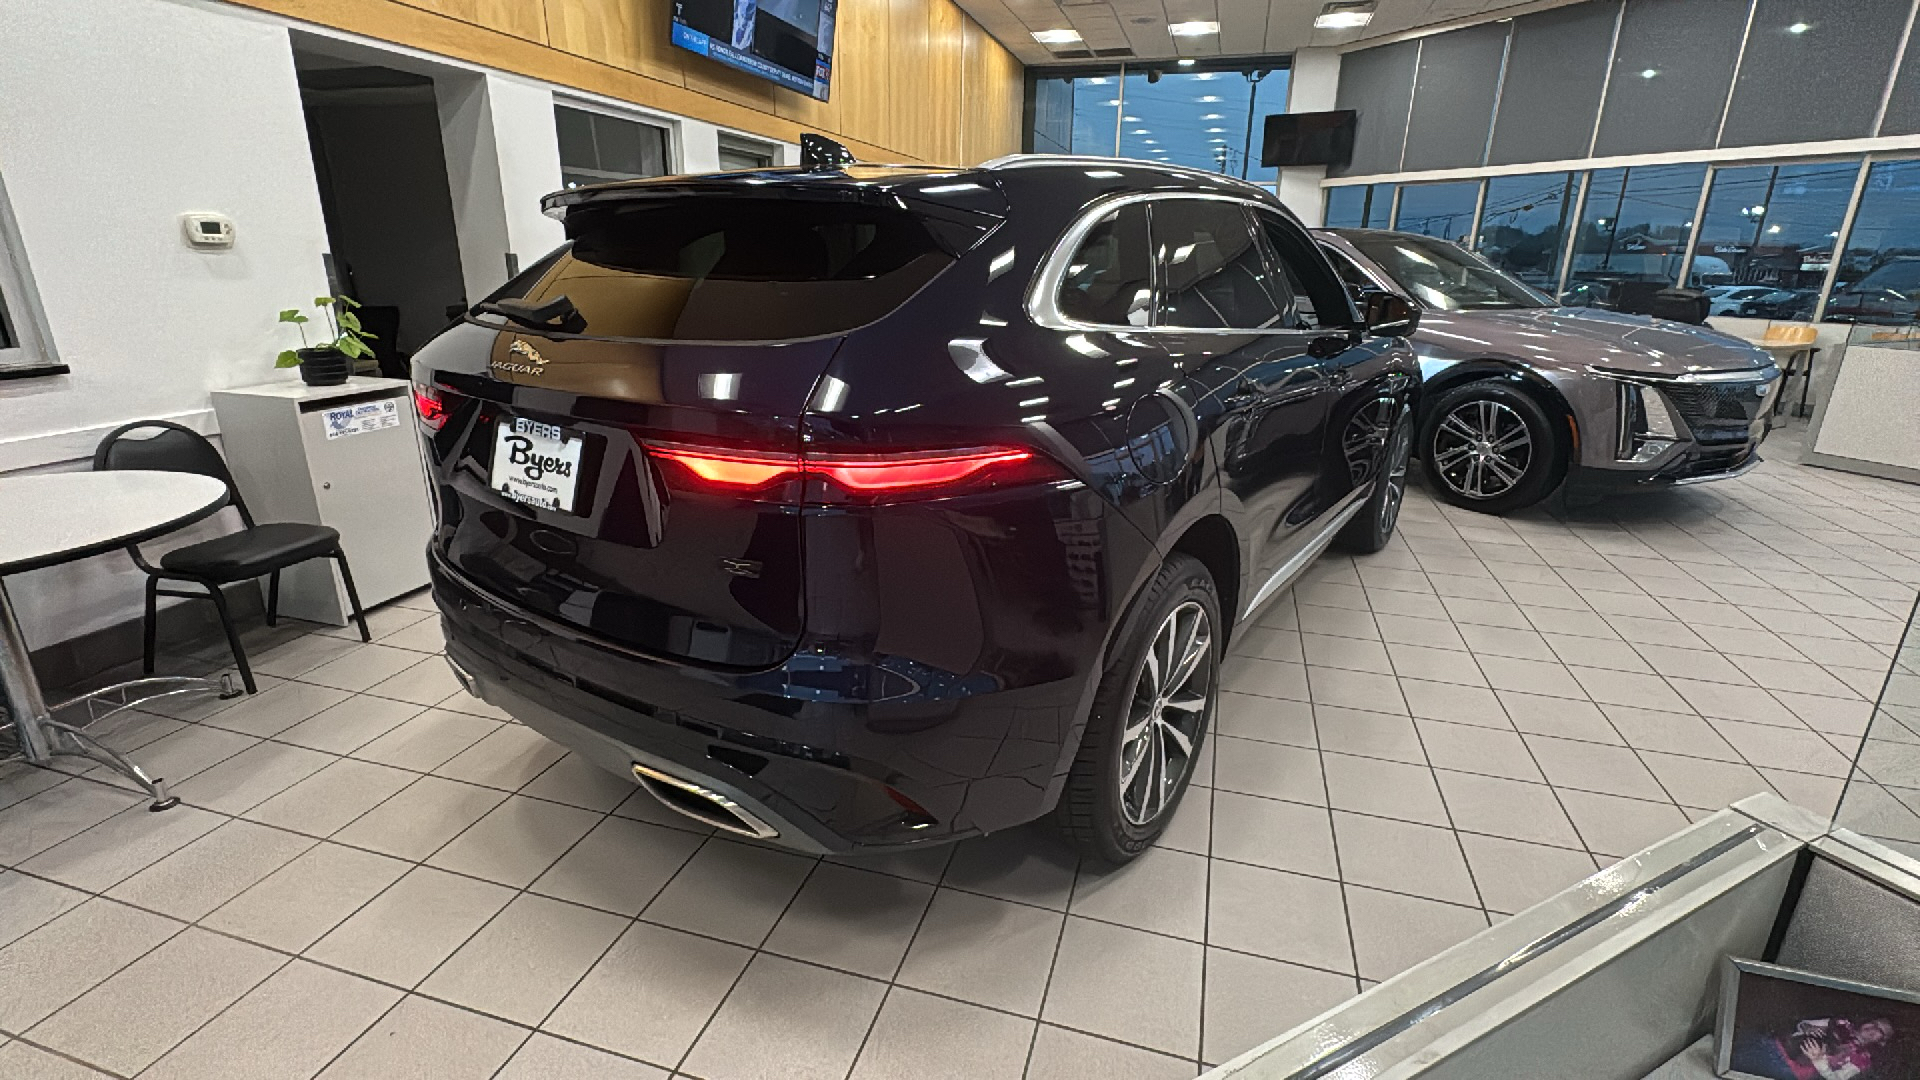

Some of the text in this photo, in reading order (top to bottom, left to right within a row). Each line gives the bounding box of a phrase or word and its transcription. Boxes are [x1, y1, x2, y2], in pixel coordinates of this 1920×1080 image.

[490, 360, 545, 377] JAGUAR
[329, 409, 354, 421] ROYAL
[516, 417, 561, 440] BYERS
[504, 435, 572, 481] Byers
